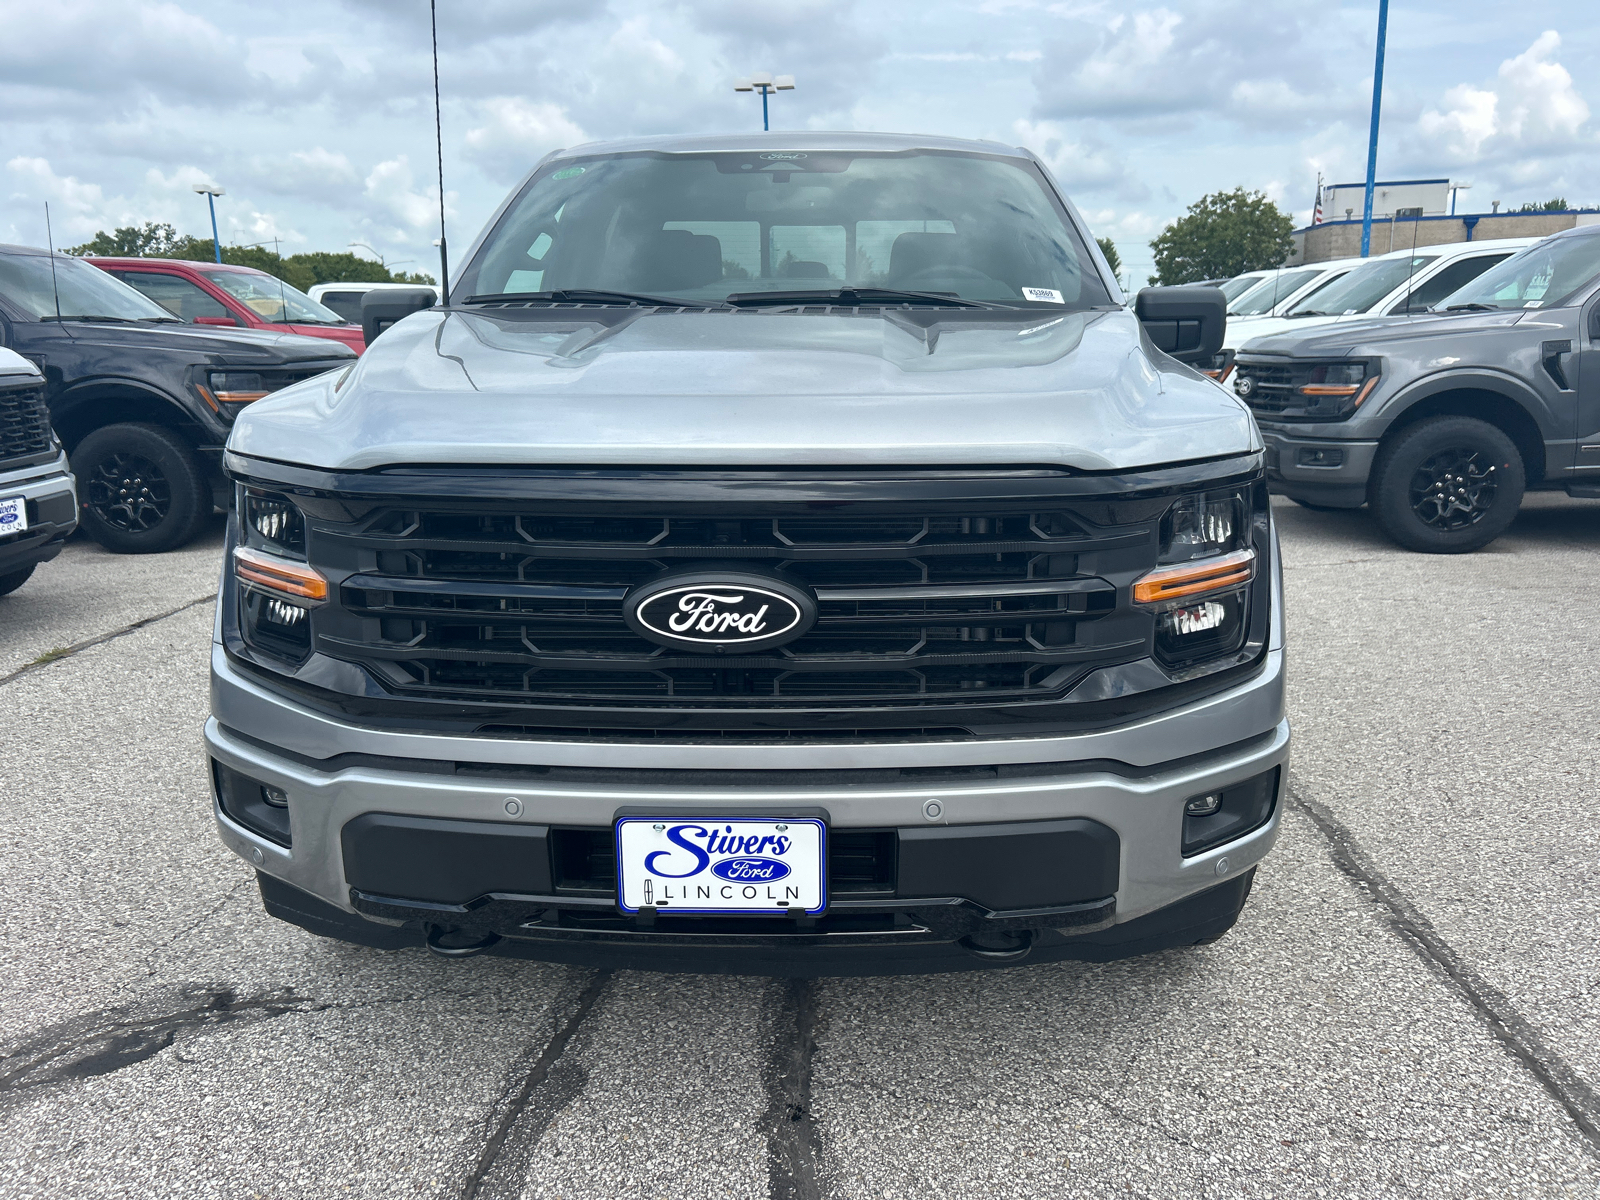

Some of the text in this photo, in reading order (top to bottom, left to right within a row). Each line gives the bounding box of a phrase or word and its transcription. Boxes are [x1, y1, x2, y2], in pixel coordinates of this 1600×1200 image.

[1, 522, 22, 531] COLN
[668, 593, 769, 633] Ford
[644, 825, 792, 878] Stivers
[727, 860, 774, 878] Ford
[664, 885, 799, 899] LINCOLN
